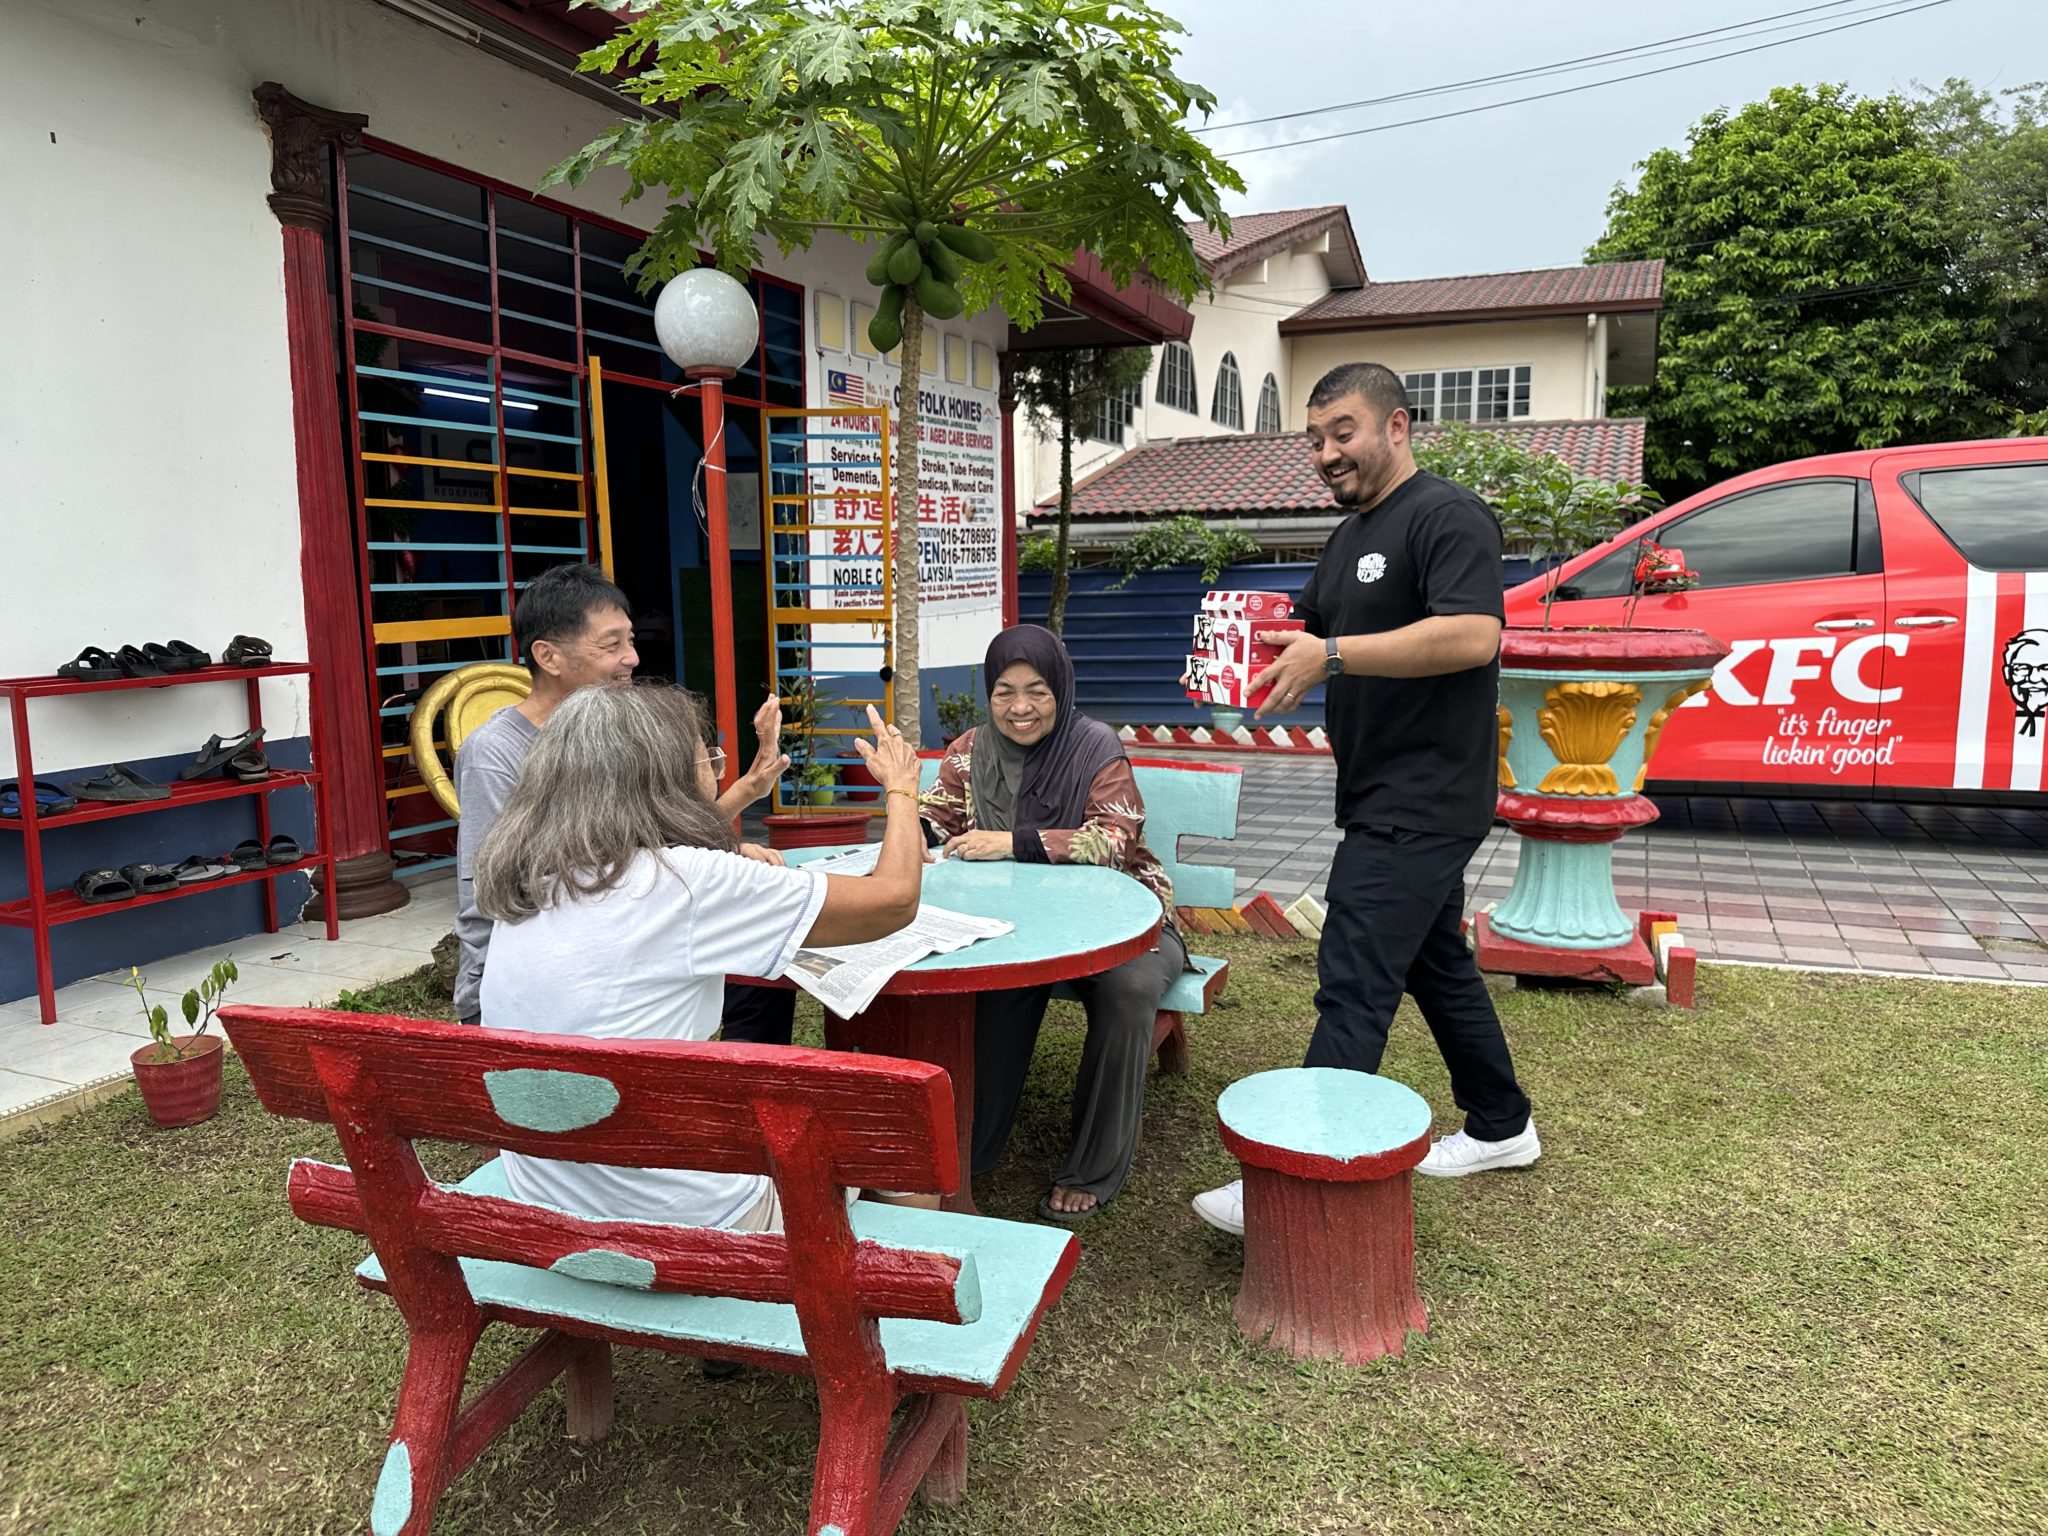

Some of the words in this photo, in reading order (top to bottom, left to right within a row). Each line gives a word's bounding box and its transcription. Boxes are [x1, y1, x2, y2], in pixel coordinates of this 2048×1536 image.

[919, 391, 946, 416] FOLK
[949, 396, 982, 422] HOMES
[831, 416, 841, 428] 24
[843, 416, 870, 433] HOURS
[930, 426, 946, 445] AGED
[948, 430, 964, 447] CARE
[965, 432, 994, 451] SERVICES
[831, 447, 871, 463] Services
[873, 452, 882, 463] fo
[922, 458, 949, 477] Stroke,
[949, 462, 967, 476] Tube
[968, 463, 994, 481] Feeding
[832, 467, 881, 488] Dementia,
[917, 477, 951, 494] andicap,
[952, 478, 976, 493] Wound
[977, 480, 994, 494] Care
[941, 527, 997, 545] 016-2786993
[917, 541, 940, 564] PEN
[941, 546, 997, 564] 016-7786795
[834, 568, 873, 585] NOBLE
[875, 568, 899, 585] CR
[917, 565, 953, 583] LAYSIA
[1680, 633, 1911, 708] KFC
[1815, 706, 1892, 745] finger
[1762, 735, 1831, 766] lickin'
